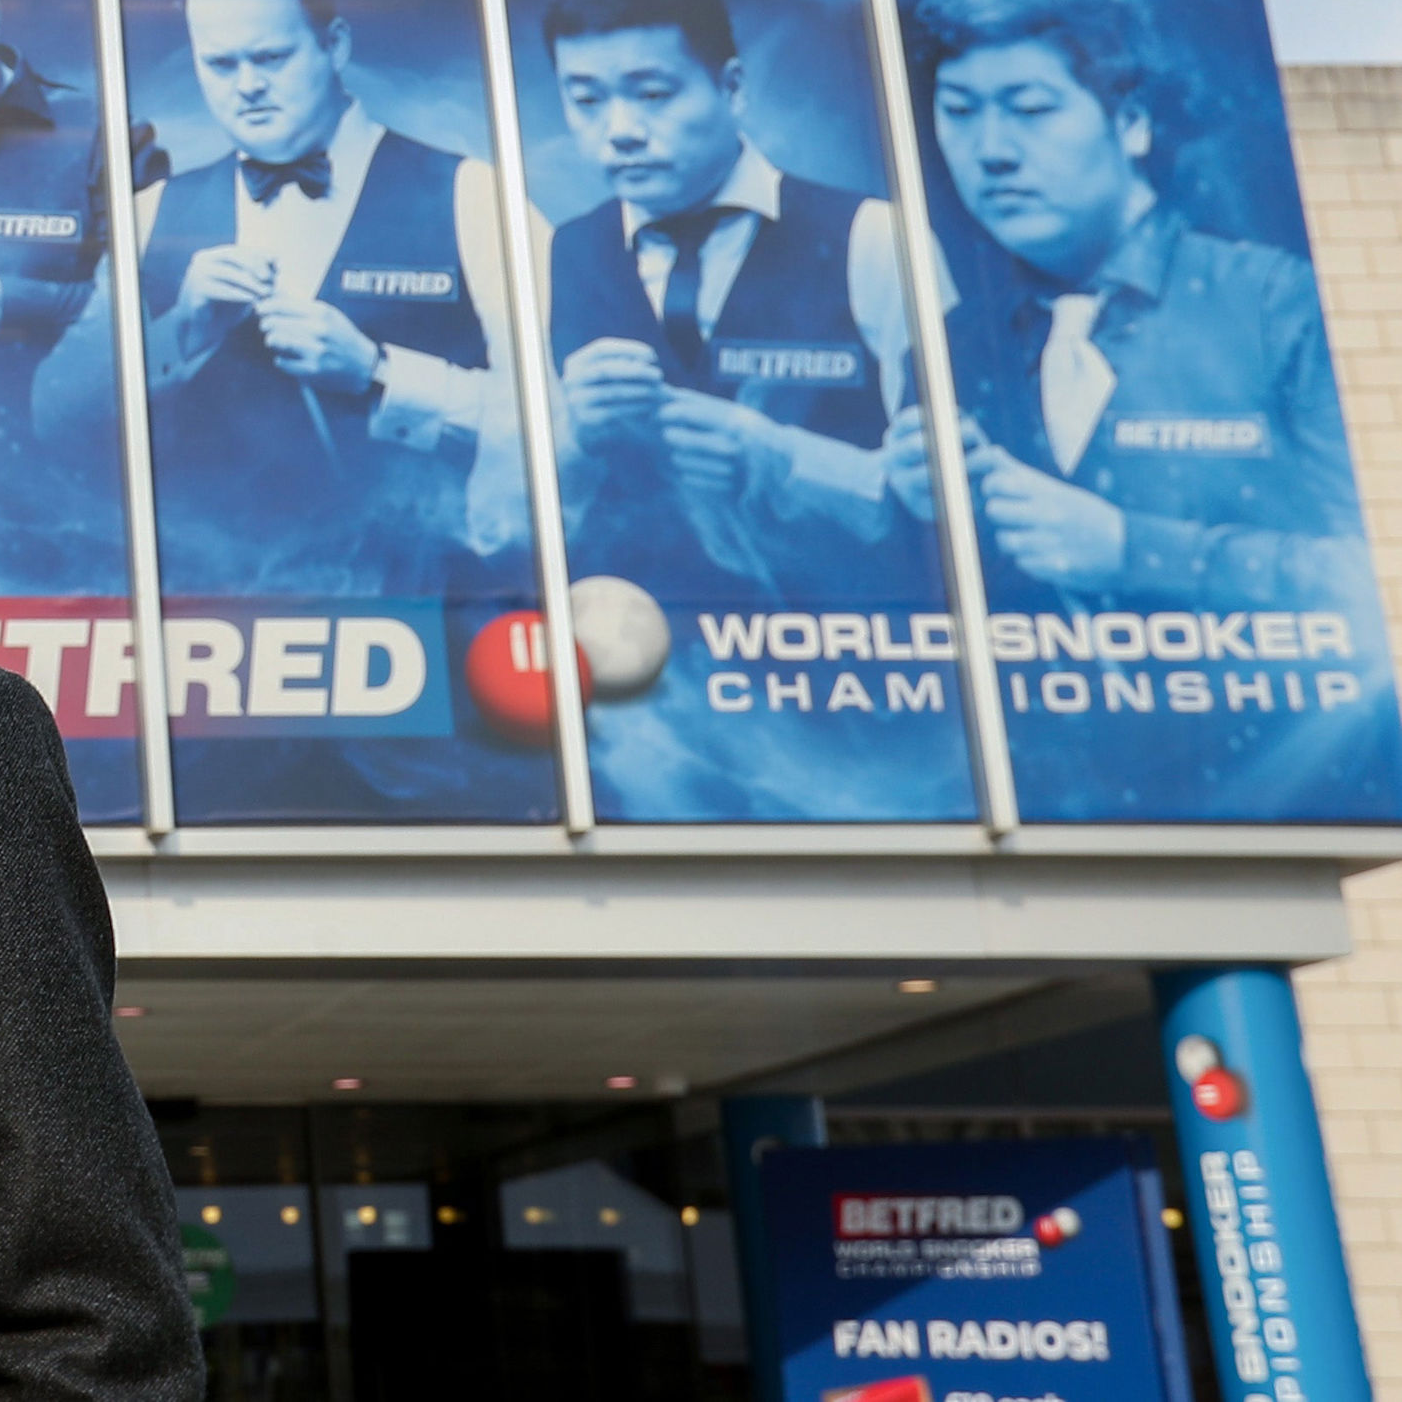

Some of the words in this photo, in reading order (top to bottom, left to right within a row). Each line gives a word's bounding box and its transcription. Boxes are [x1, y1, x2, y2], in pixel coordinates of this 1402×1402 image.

[342, 268, 453, 297] BETFRED
[719, 347, 856, 379] BETFRED
[1115, 419, 1264, 450] BETFRED
[698, 611, 962, 661] WORLD
[984, 611, 1353, 661] SNOOKER
[706, 670, 1362, 714] CHAMIONSHIP
[840, 1196, 1024, 1235] BETFRED
[1200, 1151, 1269, 1384] SNOOKER
[833, 1319, 921, 1359] FAN
[926, 1319, 1111, 1362] RADIOS!
